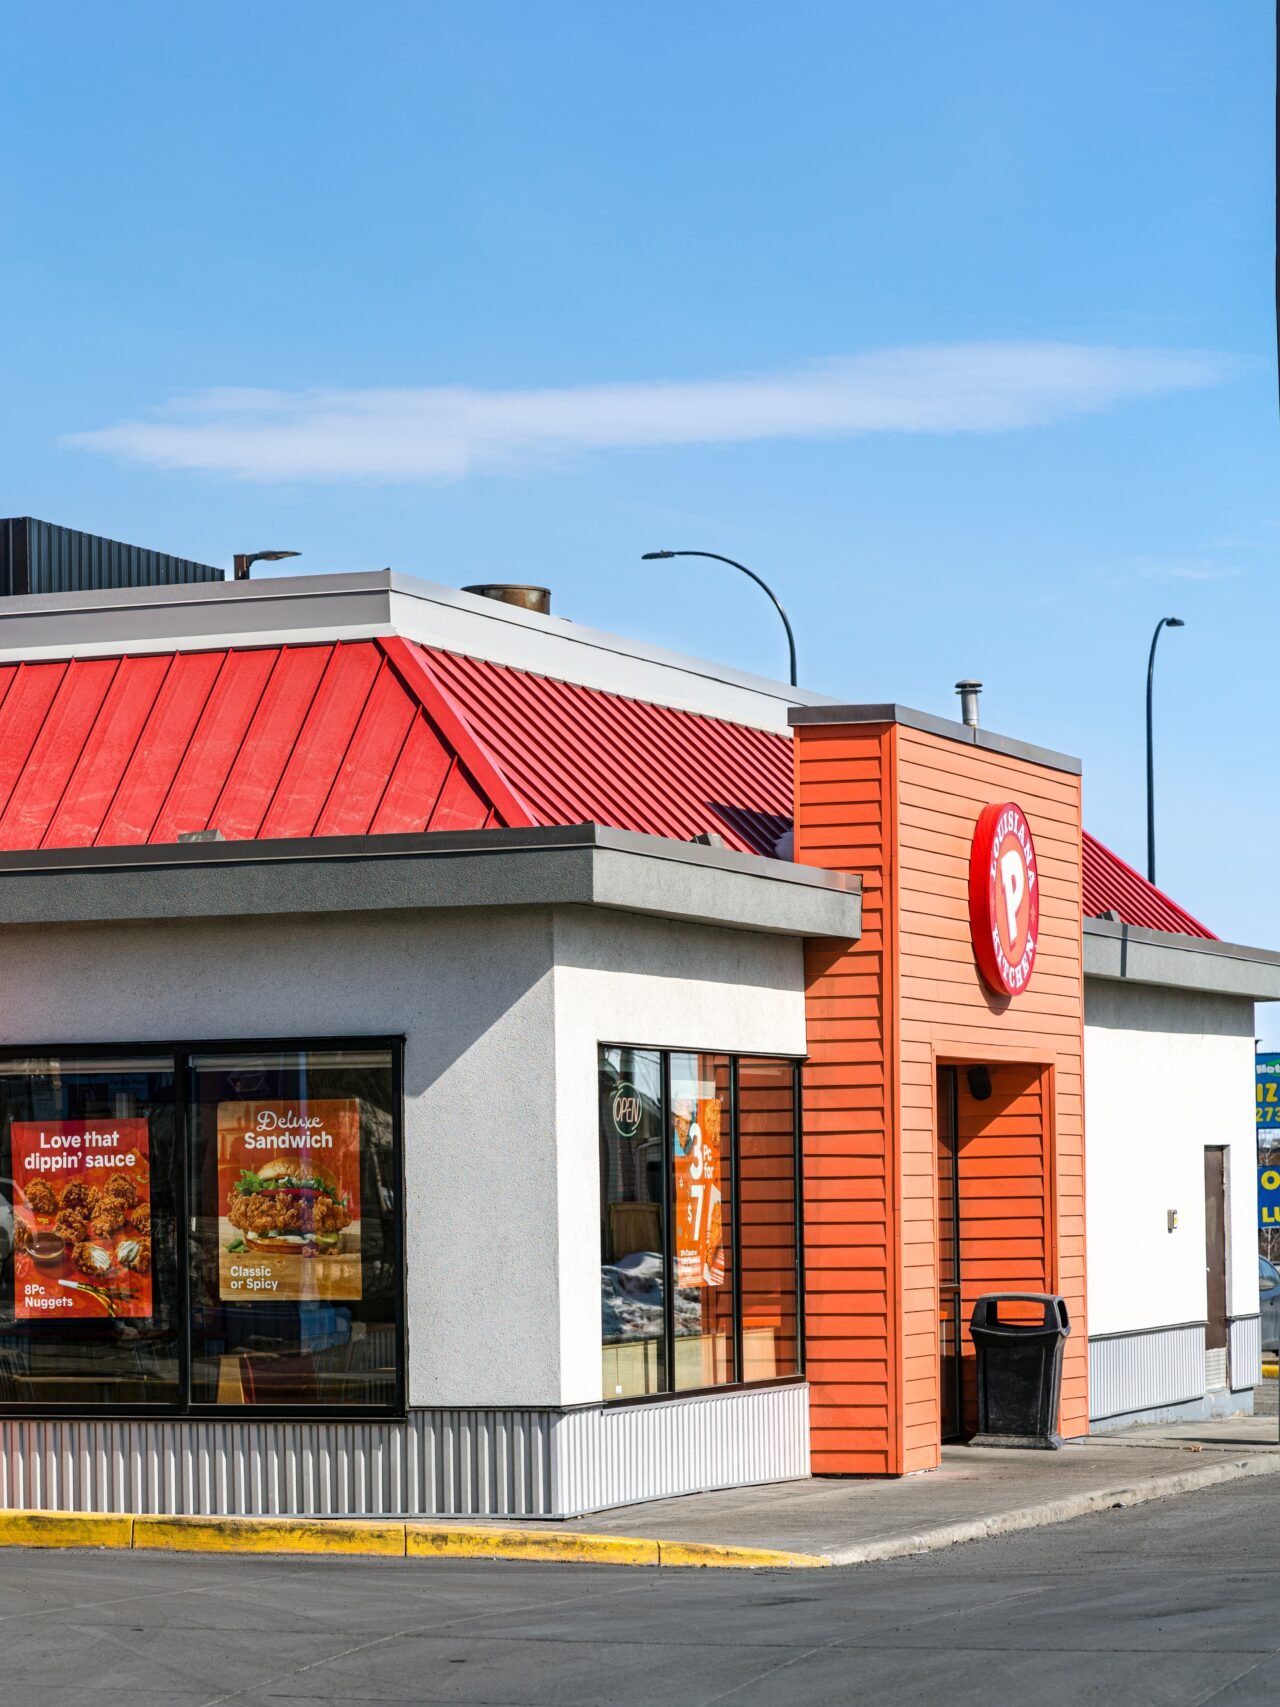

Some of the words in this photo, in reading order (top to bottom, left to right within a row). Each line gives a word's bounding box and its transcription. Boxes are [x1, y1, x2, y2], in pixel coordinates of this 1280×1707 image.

[990, 811, 1035, 891] LOUISIANA
[1001, 850, 1024, 944] P
[992, 927, 1035, 988] KITCHEN
[615, 1097, 640, 1122] OPEN
[256, 1110, 324, 1132] Deluxe
[40, 1132, 81, 1149] Love
[84, 1131, 120, 1147] that
[244, 1131, 333, 1149] Sandwich
[85, 1154, 136, 1168] sauce
[703, 1144, 713, 1162] Pc
[703, 1163, 715, 1179] for
[230, 1265, 272, 1277] Classic
[24, 1284, 46, 1295] 8Pc
[230, 1280, 244, 1289] or
[246, 1277, 279, 1291] Spicy
[24, 1296, 74, 1309] Nuggets
